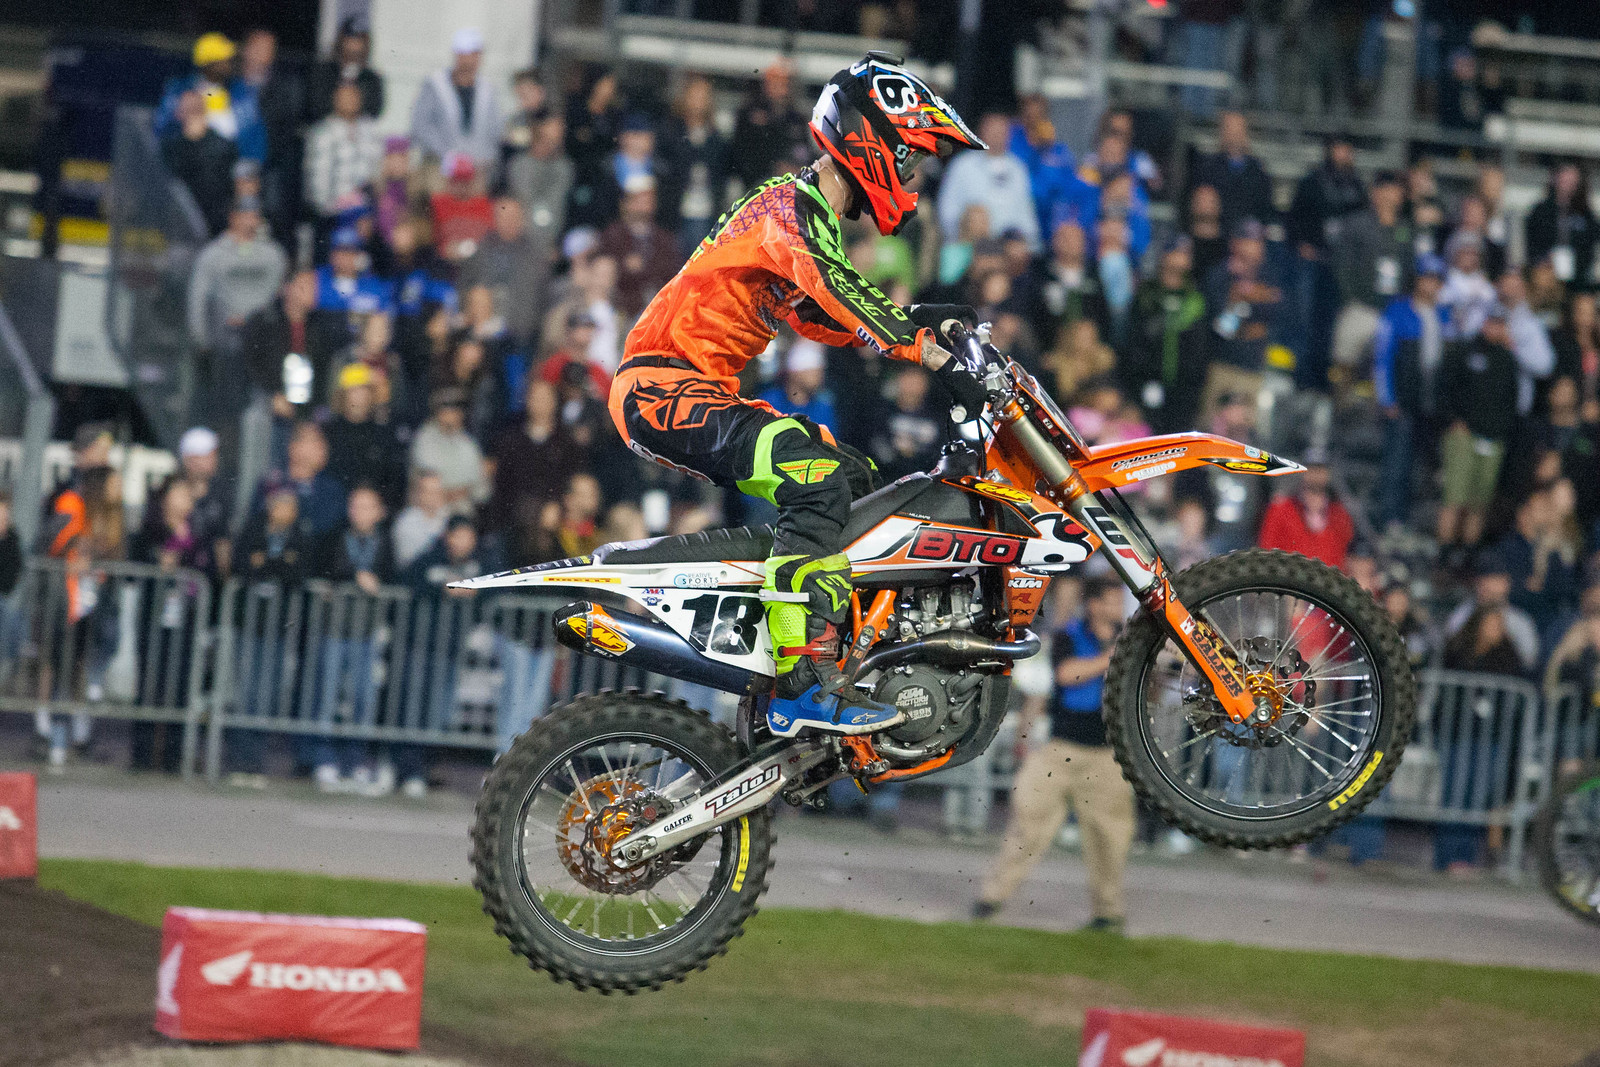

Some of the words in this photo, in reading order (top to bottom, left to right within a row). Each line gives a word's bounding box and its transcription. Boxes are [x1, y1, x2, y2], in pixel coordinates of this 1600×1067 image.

[867, 287, 908, 322] BTO
[1111, 447, 1188, 469] Palmetto
[912, 529, 1021, 564] BTO
[1008, 577, 1043, 589] KTM
[568, 617, 628, 652] FMF
[682, 594, 766, 656] 18
[1192, 629, 1243, 697] GALFER
[897, 688, 924, 701] KTM
[663, 814, 693, 833] GALFER
[249, 962, 408, 994] HONDA
